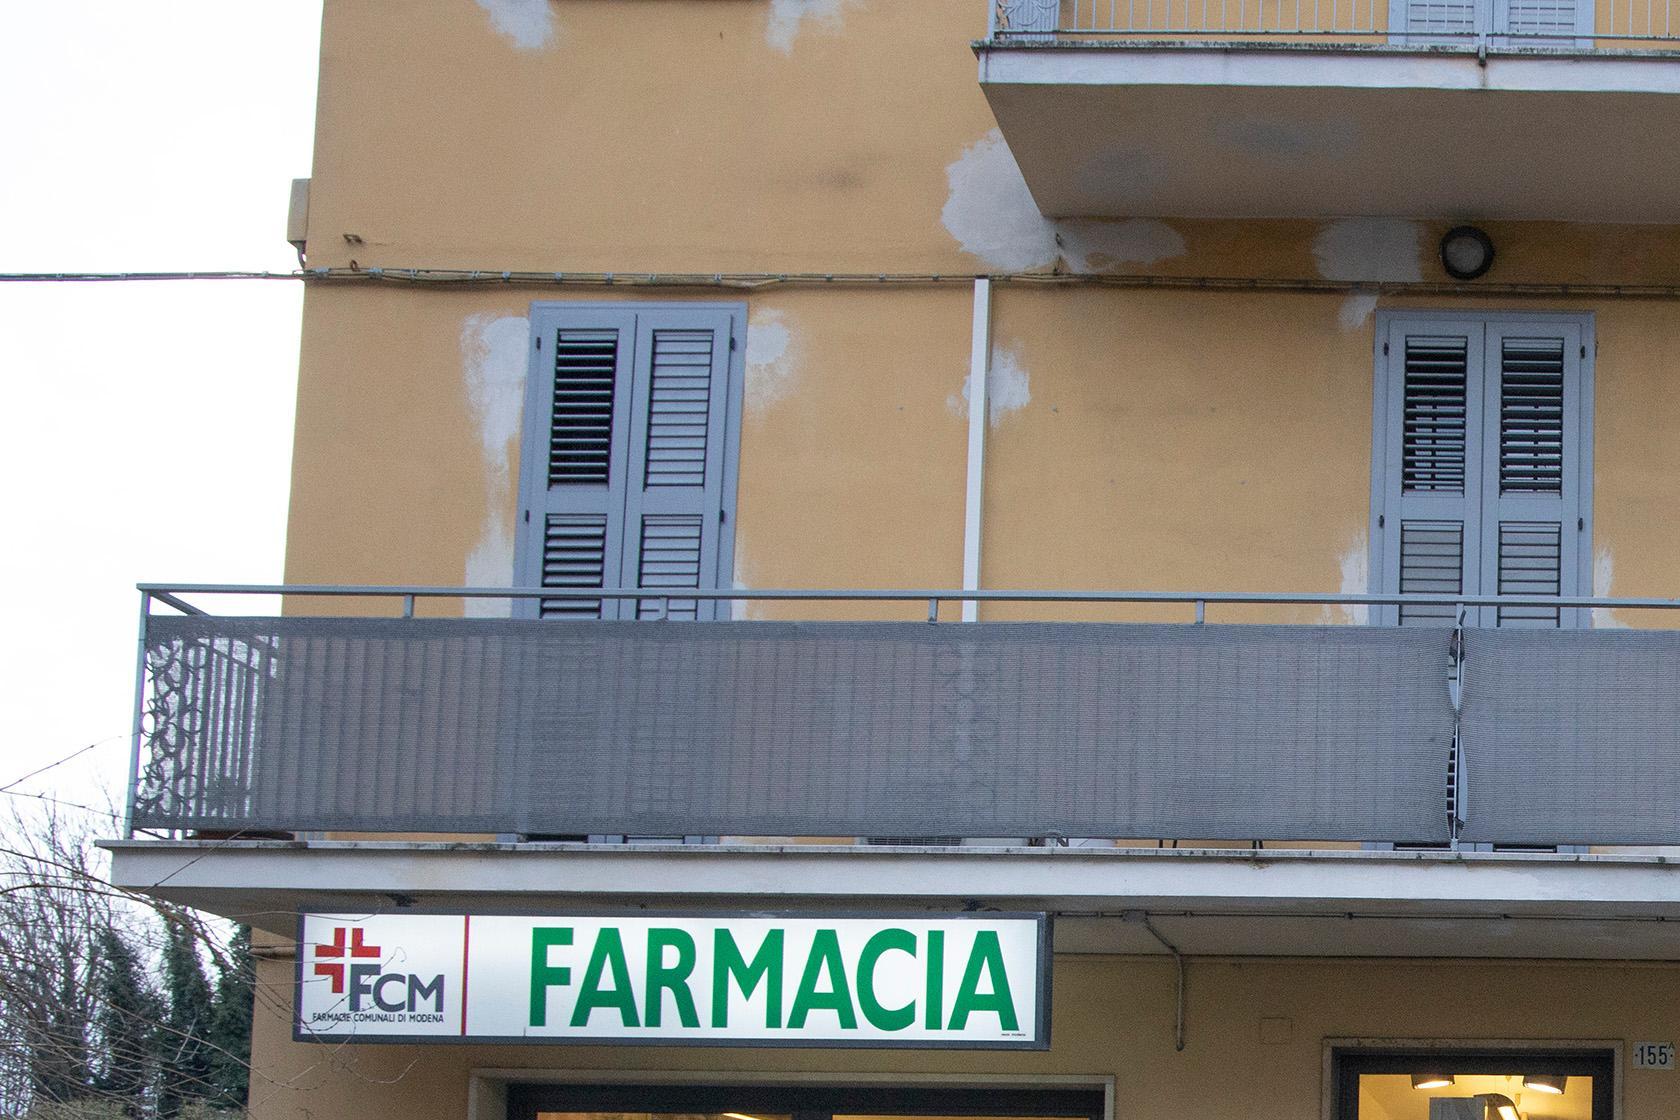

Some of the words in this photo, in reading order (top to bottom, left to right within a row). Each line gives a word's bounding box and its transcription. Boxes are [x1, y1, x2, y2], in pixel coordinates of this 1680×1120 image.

[350, 963, 445, 1013] FCM
[530, 927, 1020, 1032] FARMACIA
[312, 1013, 351, 1022] FARMACIE
[353, 1013, 396, 1022] COMUNALI
[397, 1013, 407, 1022] DI
[408, 1013, 445, 1023] MODENA
[1640, 1045, 1668, 1065] 155
